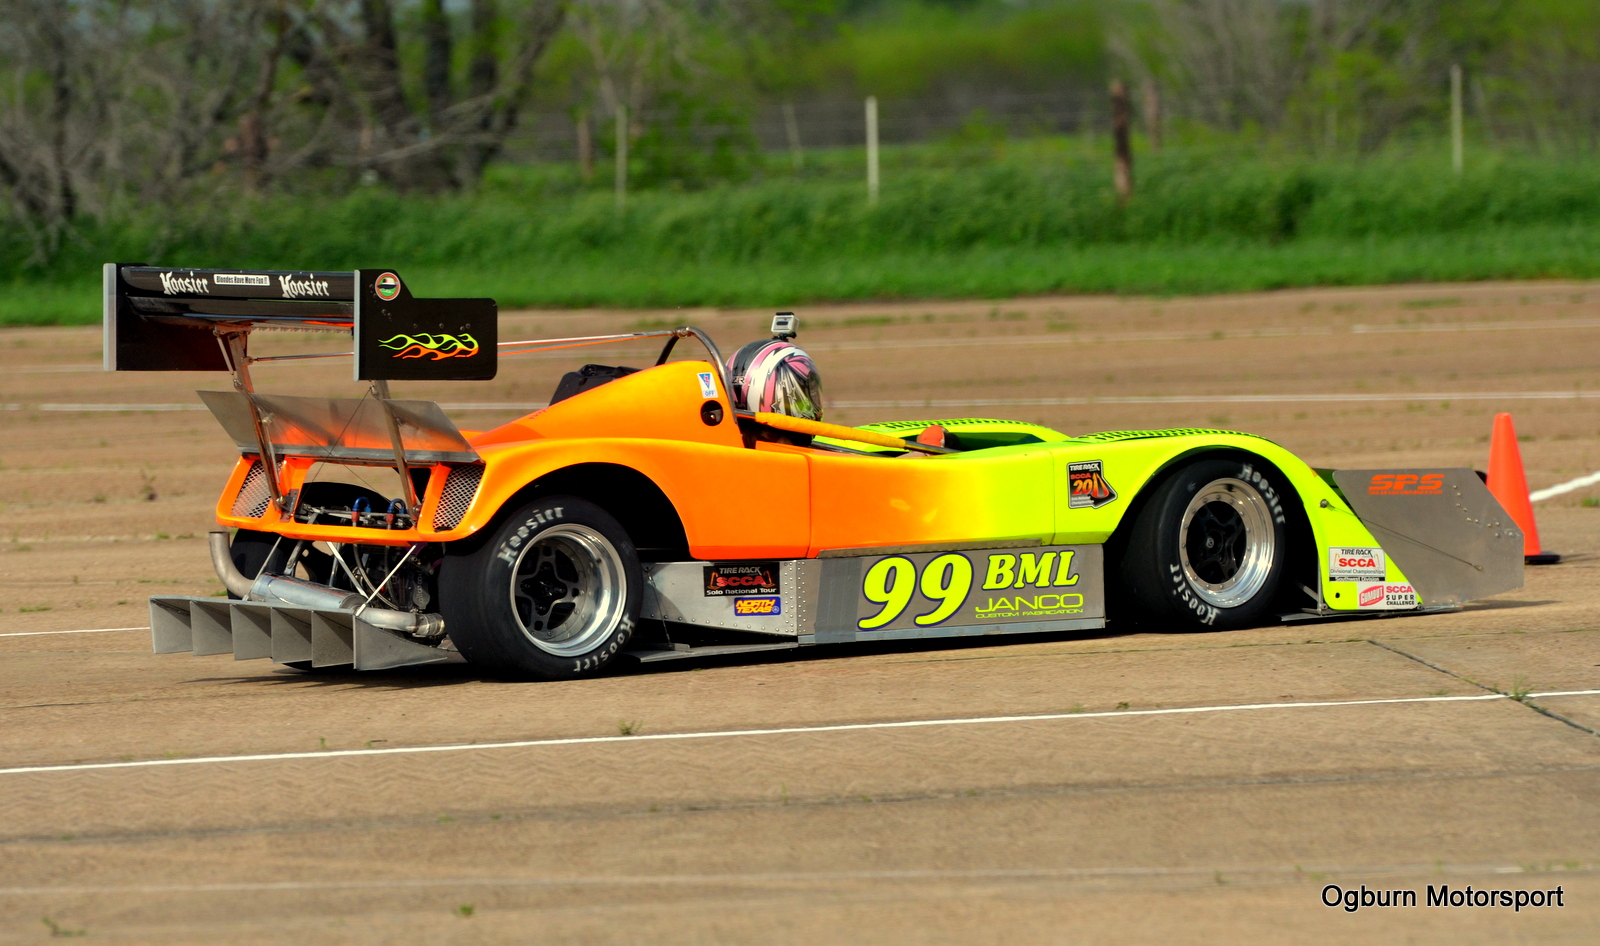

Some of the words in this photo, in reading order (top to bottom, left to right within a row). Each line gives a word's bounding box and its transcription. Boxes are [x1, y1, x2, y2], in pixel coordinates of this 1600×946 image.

[159, 270, 210, 295] Hoosier
[216, 275, 234, 283] Blondes
[245, 276, 256, 284] More
[256, 276, 264, 284] Fun
[278, 273, 330, 298] Hoosier
[1083, 463, 1100, 471] RACK
[1070, 472, 1092, 480] SCCA
[1368, 474, 1445, 490] SPS
[1071, 478, 1093, 495] 20
[1236, 462, 1287, 525] Hoosier
[496, 506, 564, 569] Hoosier
[1355, 549, 1374, 558] RACK
[738, 566, 762, 576] RACK
[981, 550, 1080, 591] BML
[1338, 558, 1376, 568] SCCA
[716, 576, 767, 587] SCCA
[1386, 585, 1413, 593] SCCA
[857, 551, 974, 632] 99
[1169, 563, 1222, 626] Hoosier
[735, 599, 776, 607] NORTH
[736, 606, 773, 614] TEXAS
[975, 593, 1084, 613] JANCO
[573, 612, 636, 673] Hoosier
